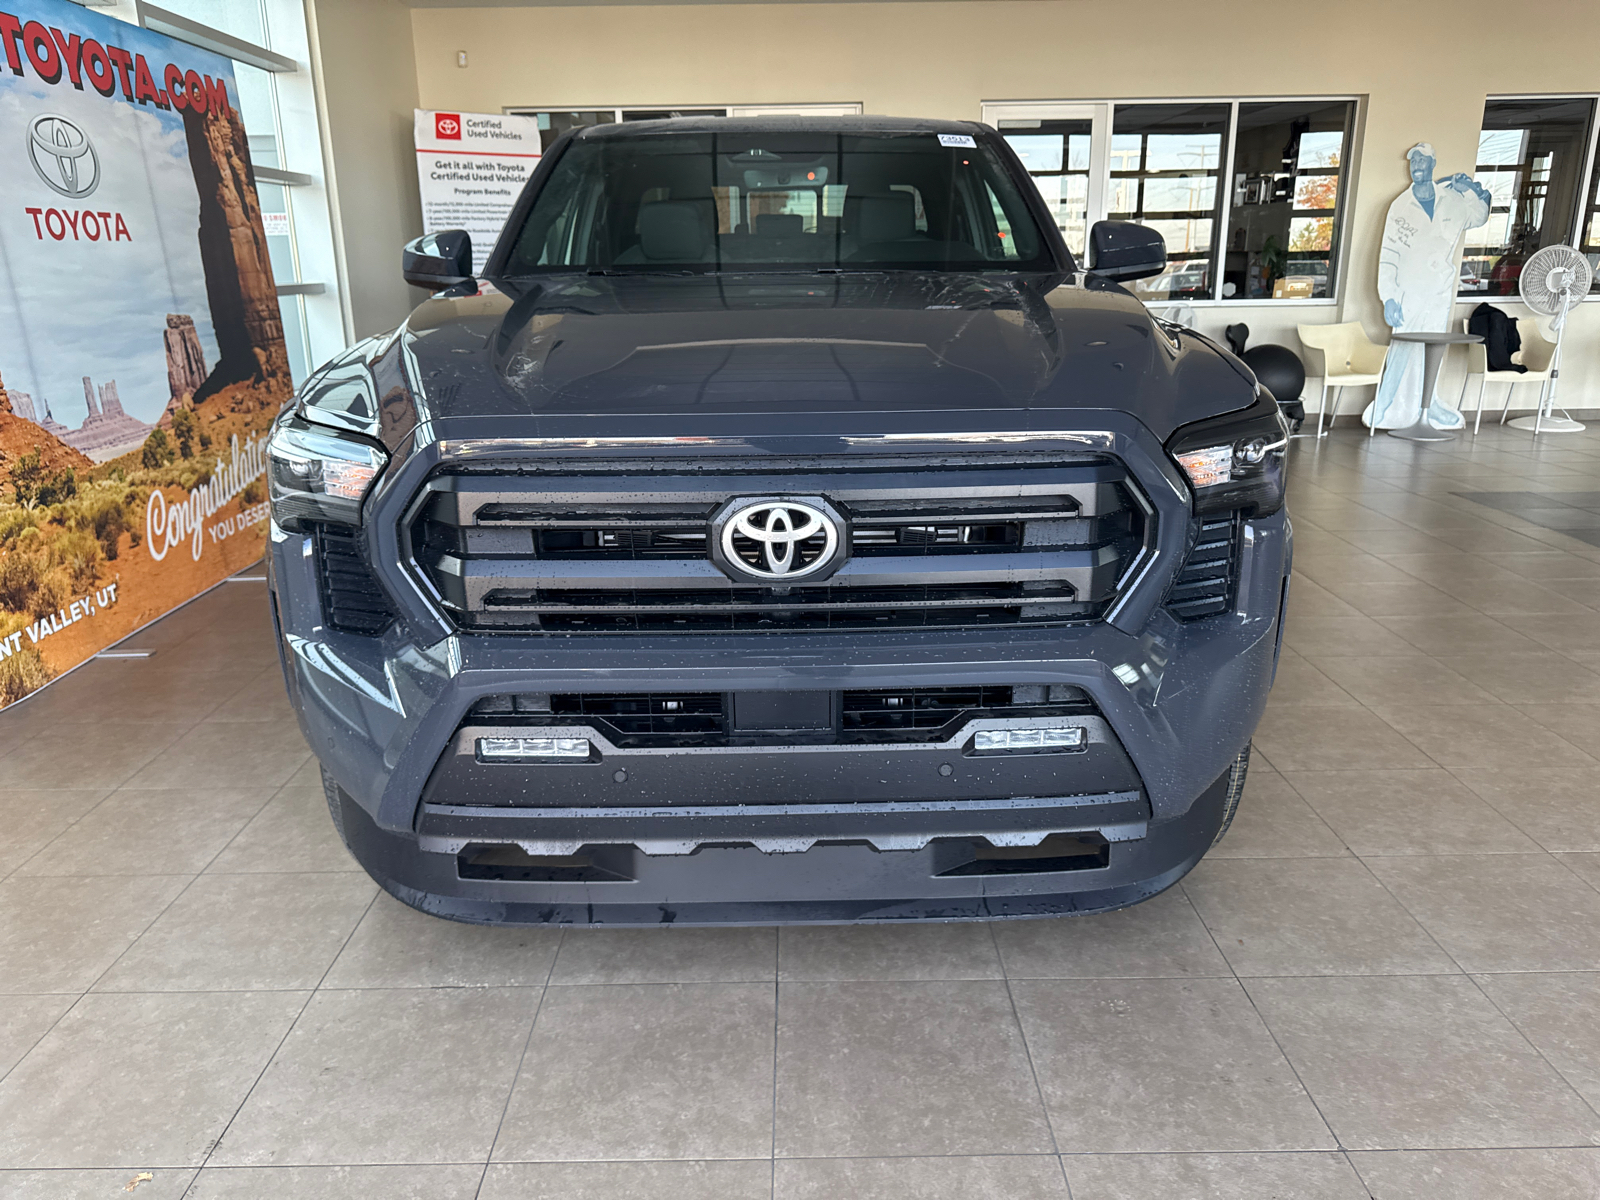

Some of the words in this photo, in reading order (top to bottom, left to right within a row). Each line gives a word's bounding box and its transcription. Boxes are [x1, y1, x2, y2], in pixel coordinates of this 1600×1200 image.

[466, 119, 502, 129] Certified
[467, 129, 489, 139] Used
[489, 130, 522, 141] Vehicles
[435, 161, 452, 170] Get
[453, 161, 461, 170] it
[462, 162, 474, 171] all
[475, 162, 496, 172] with
[496, 163, 525, 173] Toyota
[430, 172, 471, 182] Certified
[472, 173, 495, 183] Used
[454, 187, 484, 197] Program
[484, 188, 512, 197] Benefits
[25, 207, 133, 242] TOYOTA
[208, 517, 235, 544] YOU
[25, 596, 96, 644] VALLEY,
[95, 583, 118, 608] UT
